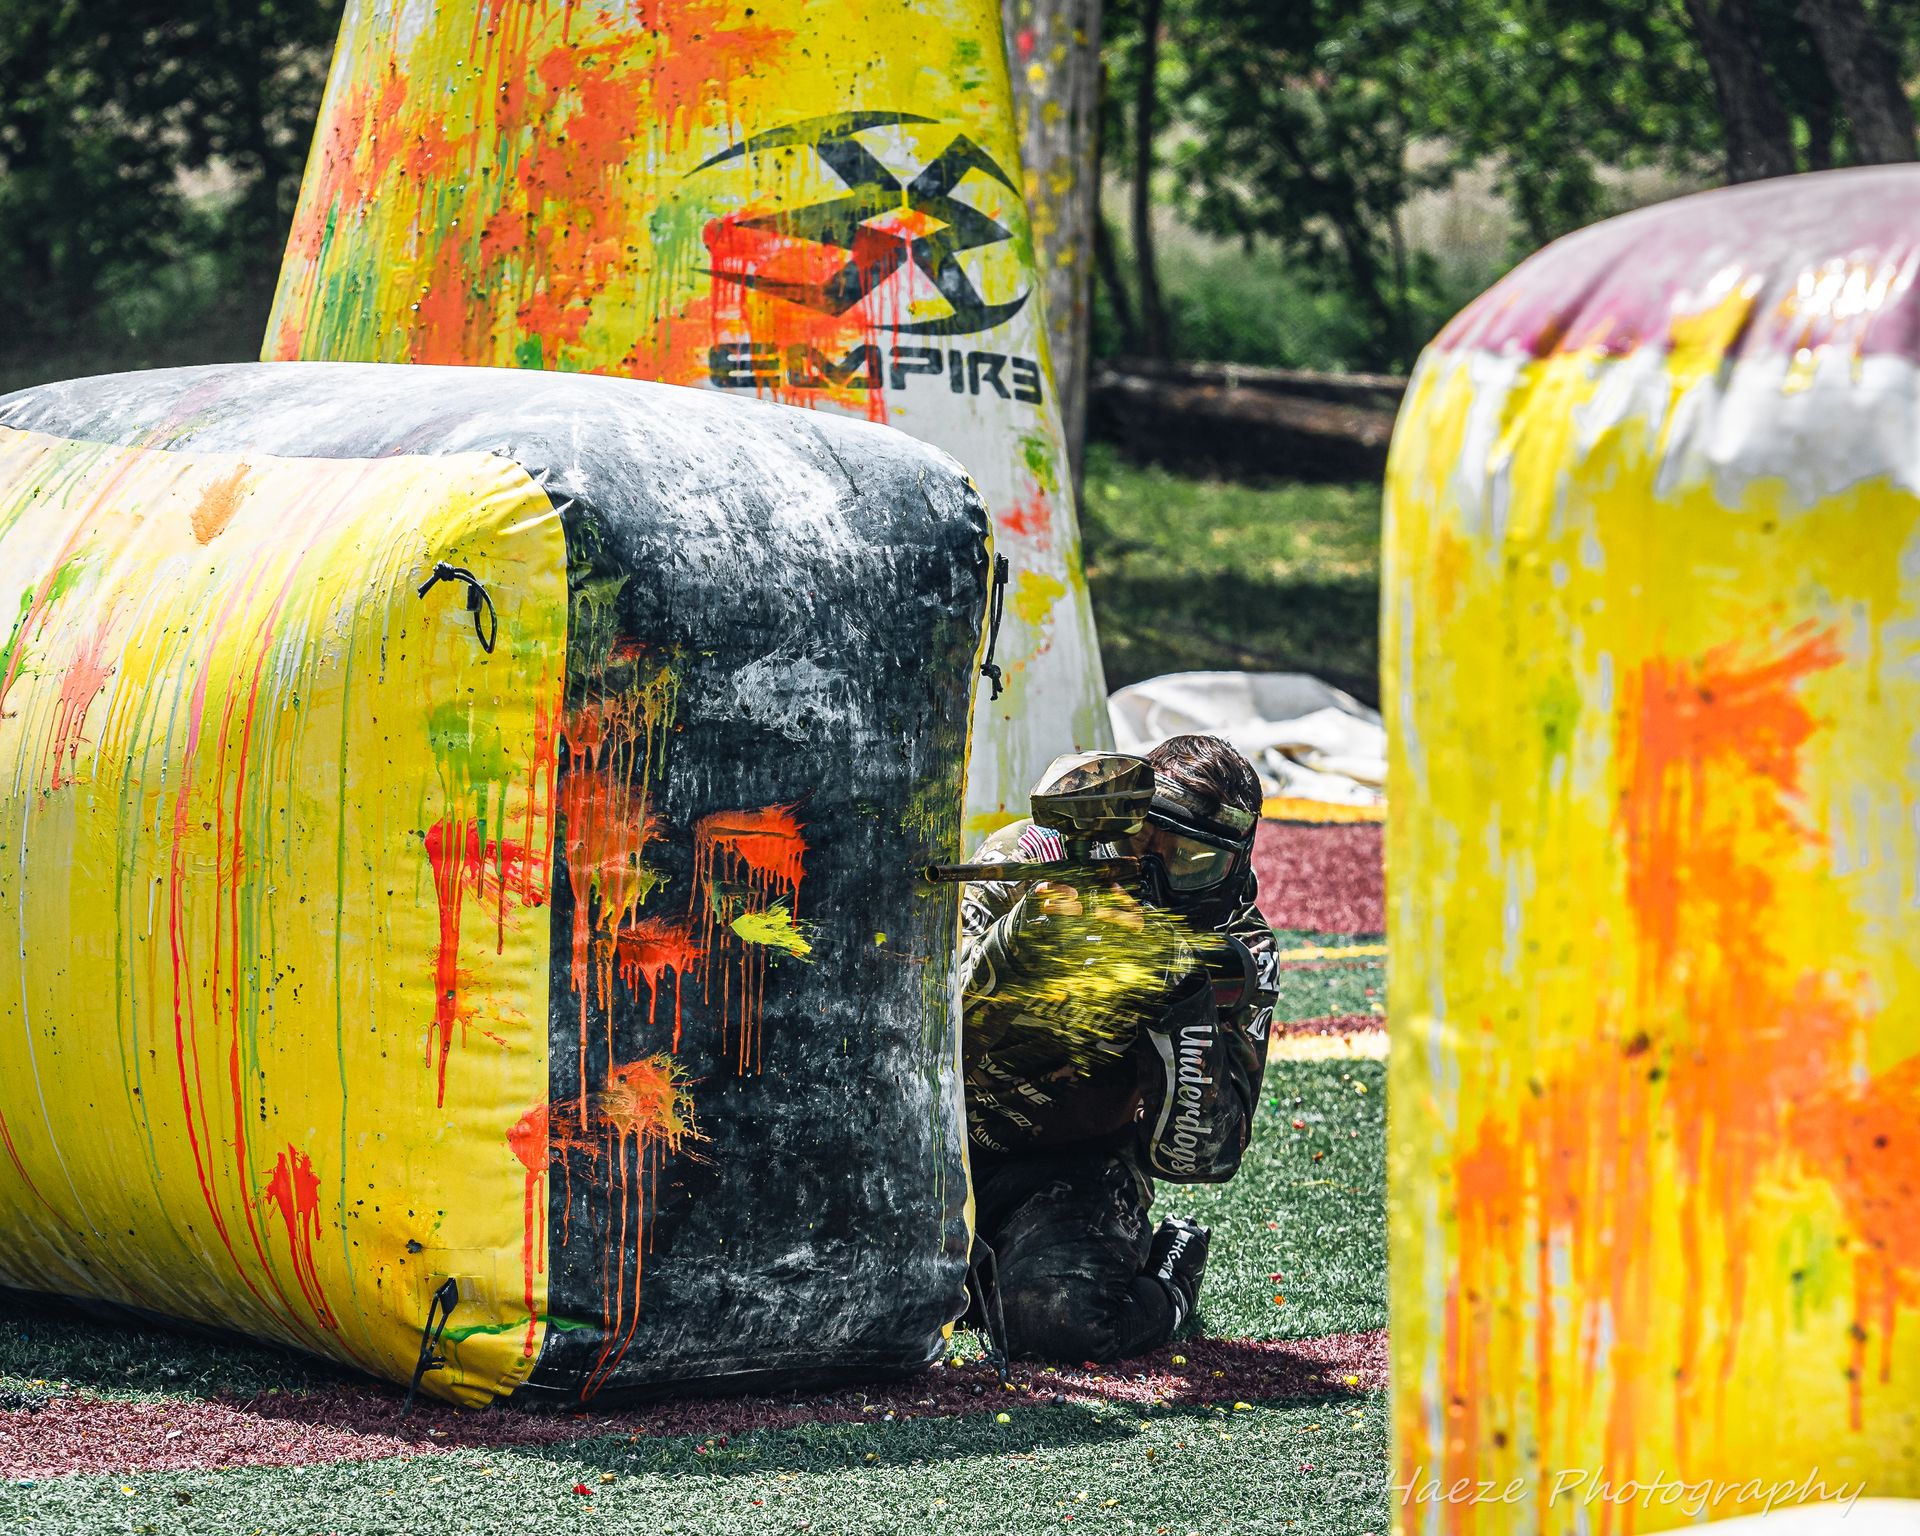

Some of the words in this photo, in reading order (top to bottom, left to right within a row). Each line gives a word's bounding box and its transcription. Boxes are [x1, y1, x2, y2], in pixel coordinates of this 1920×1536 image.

[708, 342, 1043, 405] EMPIRE
[987, 1063, 1053, 1105] VIUE
[1159, 1025, 1213, 1174] Underdogs
